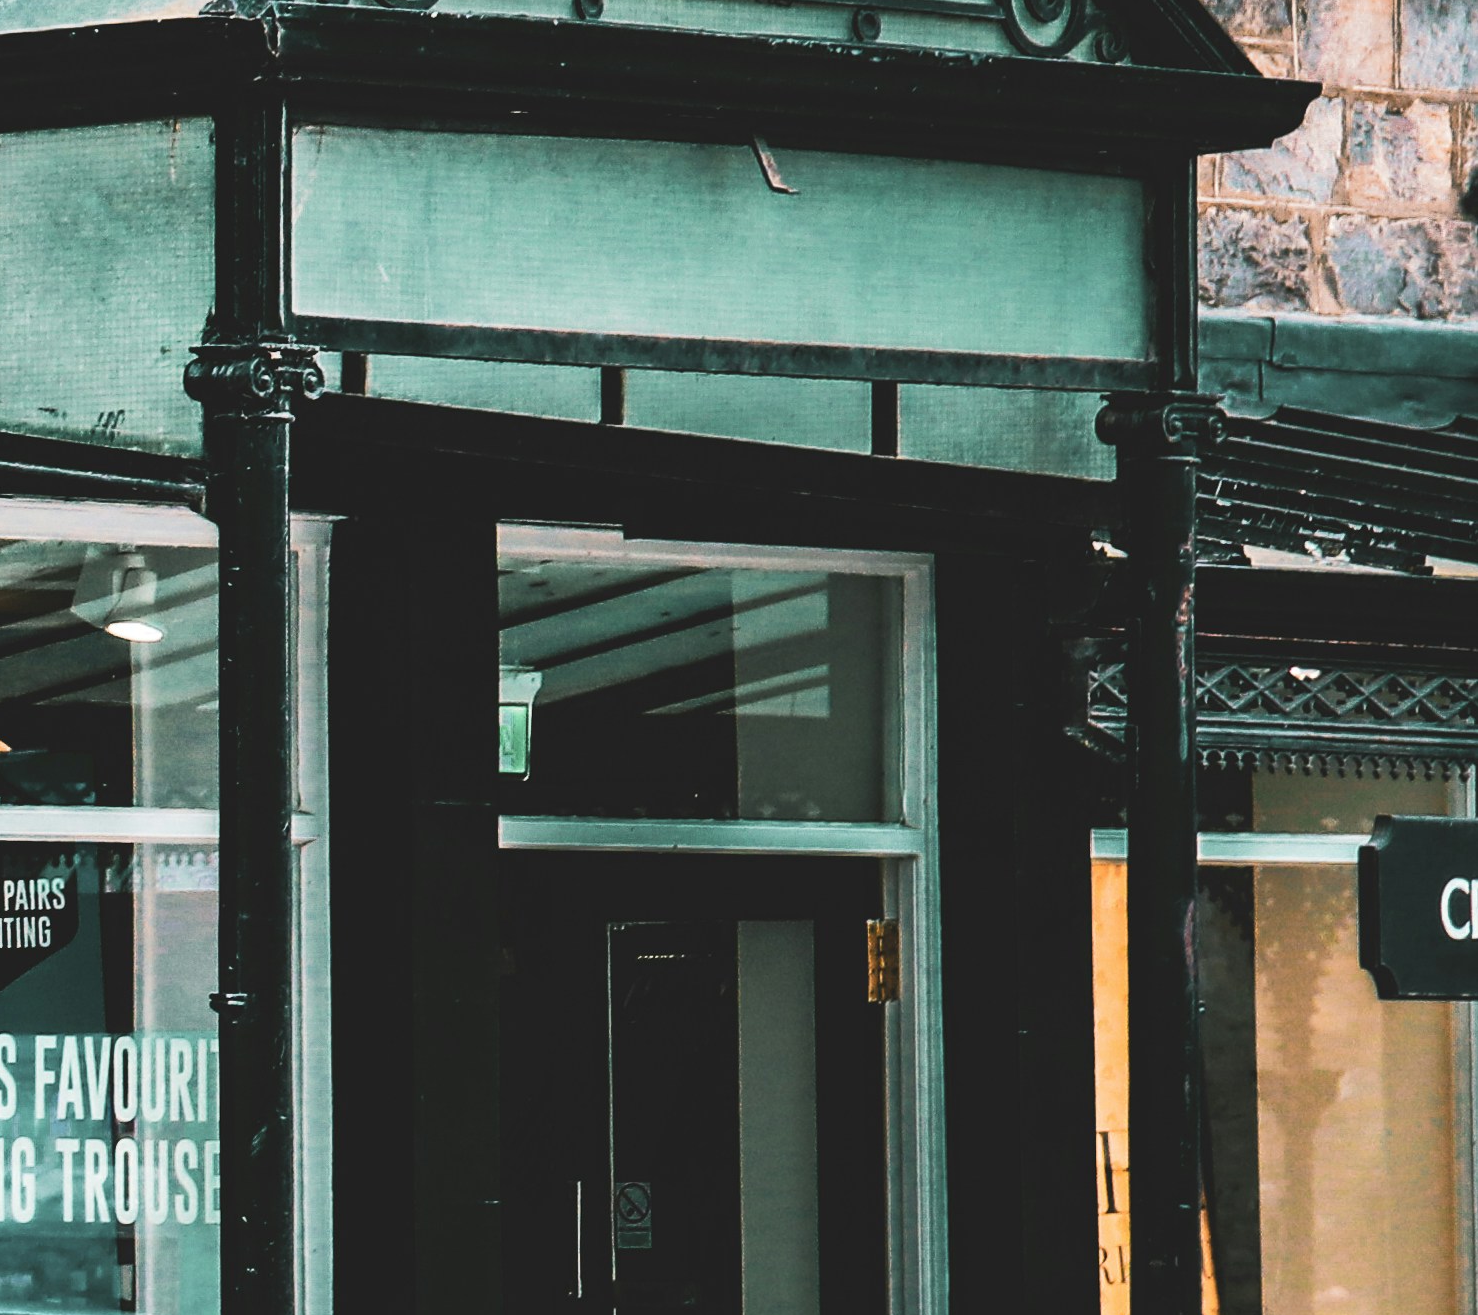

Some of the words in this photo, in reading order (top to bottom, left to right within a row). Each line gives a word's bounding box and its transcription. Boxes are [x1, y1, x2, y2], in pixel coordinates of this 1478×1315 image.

[3, 877, 66, 912] PAIRS
[1440, 877, 1478, 940] C
[56, 1139, 220, 1224] TROUSE
